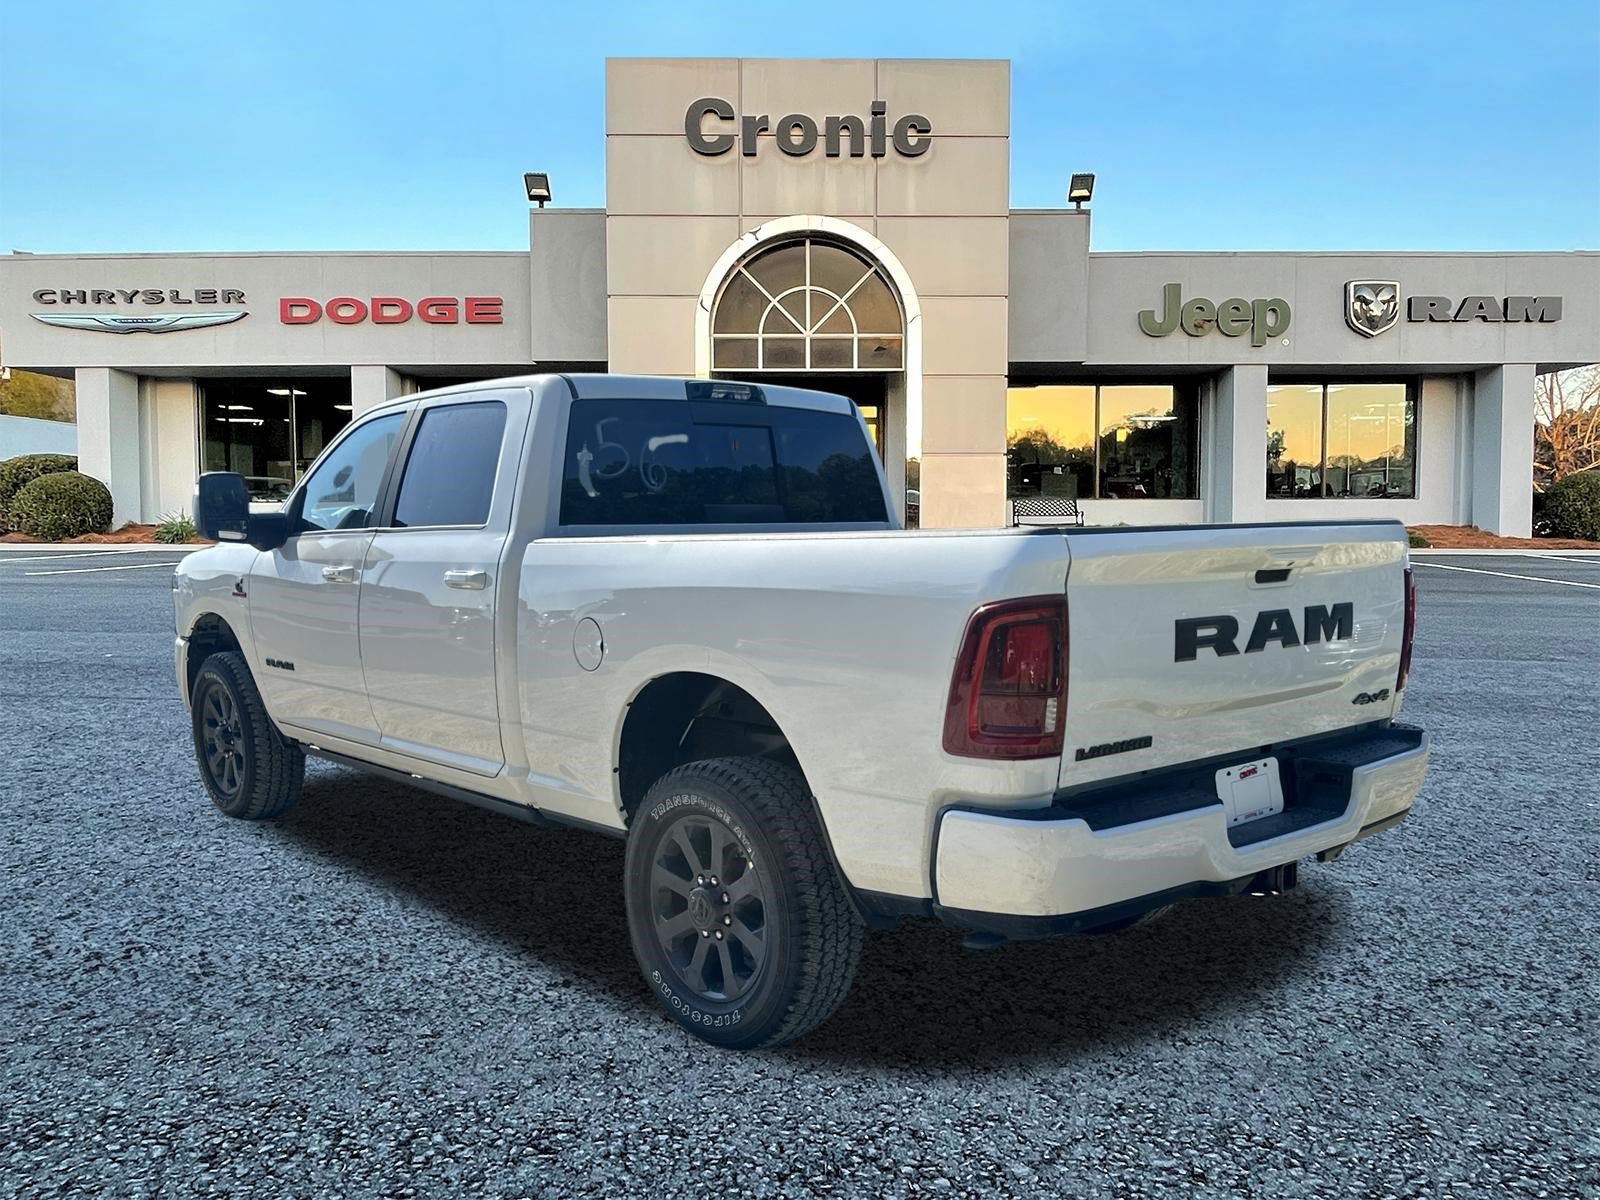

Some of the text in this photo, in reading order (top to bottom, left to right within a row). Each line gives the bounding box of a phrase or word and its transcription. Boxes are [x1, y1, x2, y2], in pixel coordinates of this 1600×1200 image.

[685, 98, 932, 157] Cronic
[32, 288, 247, 305] CHRYSLER
[279, 297, 504, 325] DODGE
[1138, 283, 1292, 348] Jeep
[1407, 296, 1563, 323] RAM
[1174, 601, 1354, 663] RAM
